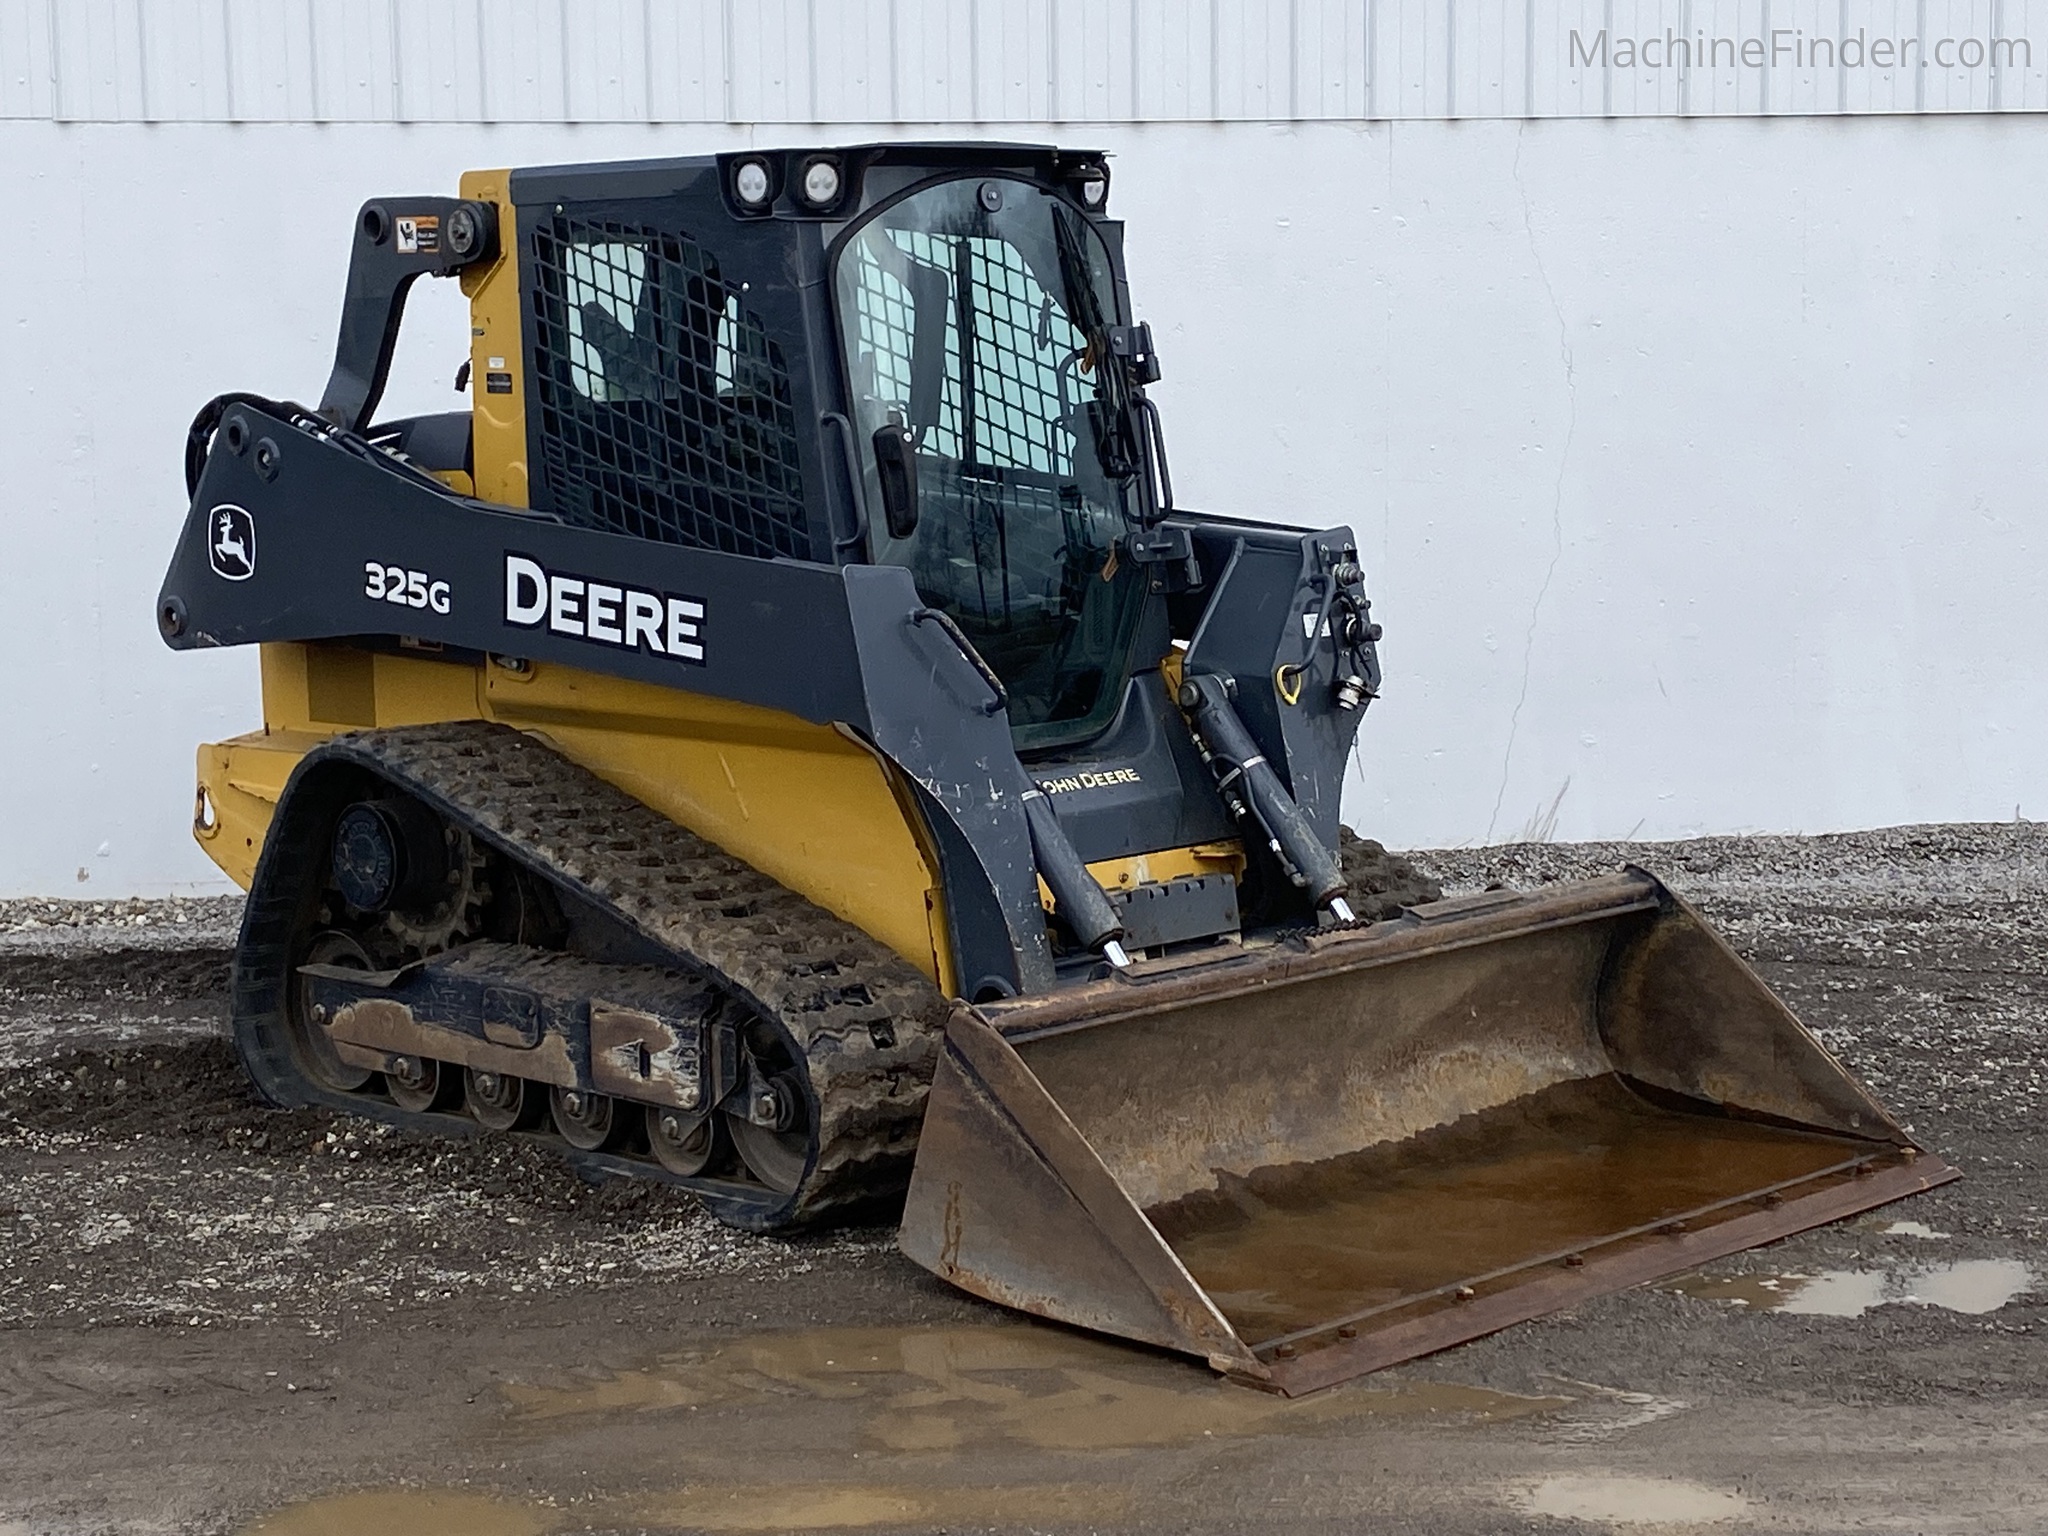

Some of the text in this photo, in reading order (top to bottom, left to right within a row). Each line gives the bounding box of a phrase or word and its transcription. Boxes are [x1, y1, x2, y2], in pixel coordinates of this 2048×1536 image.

[365, 562, 451, 614] 325G
[506, 555, 704, 660] DEERE
[1035, 768, 1141, 794] OHN DEERE
